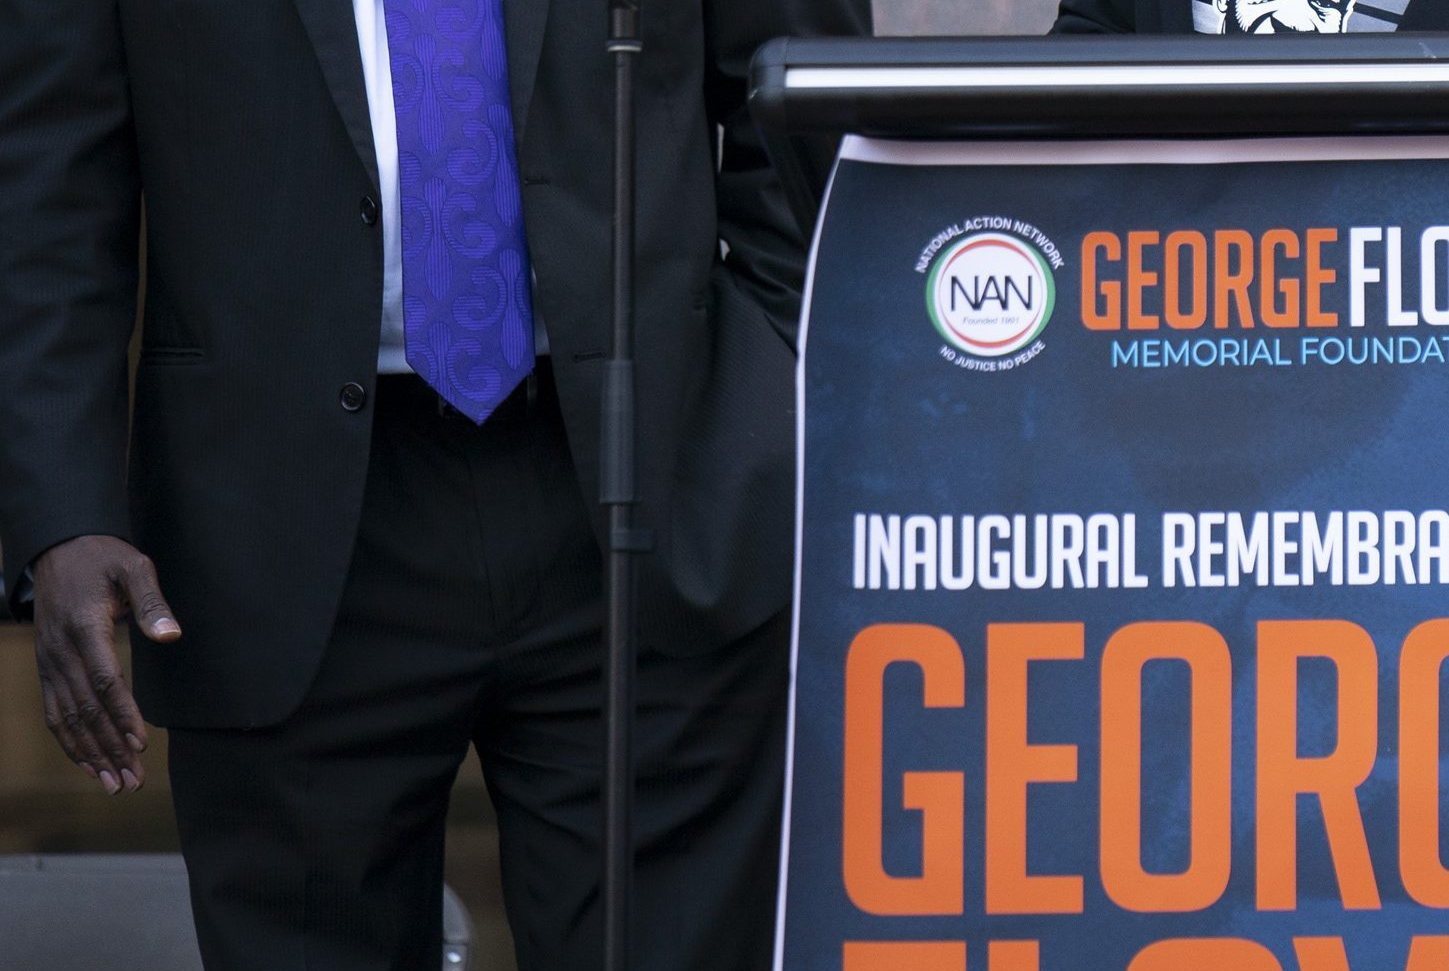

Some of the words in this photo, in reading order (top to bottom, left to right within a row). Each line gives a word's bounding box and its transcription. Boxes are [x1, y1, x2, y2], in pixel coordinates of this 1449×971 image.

[914, 224, 965, 274] NATIONAL
[964, 216, 1012, 231] ACTION
[1014, 221, 1065, 271] NETWORK
[950, 275, 1033, 311] NAN
[1081, 228, 1339, 331] GEORGE
[939, 344, 956, 361] NO
[955, 357, 997, 371] JUSTICE
[998, 359, 1014, 370] NO
[1014, 340, 1047, 367] PEACE
[1111, 338, 1292, 368] MEMORIAL
[853, 512, 1149, 591] INAUGURAL
